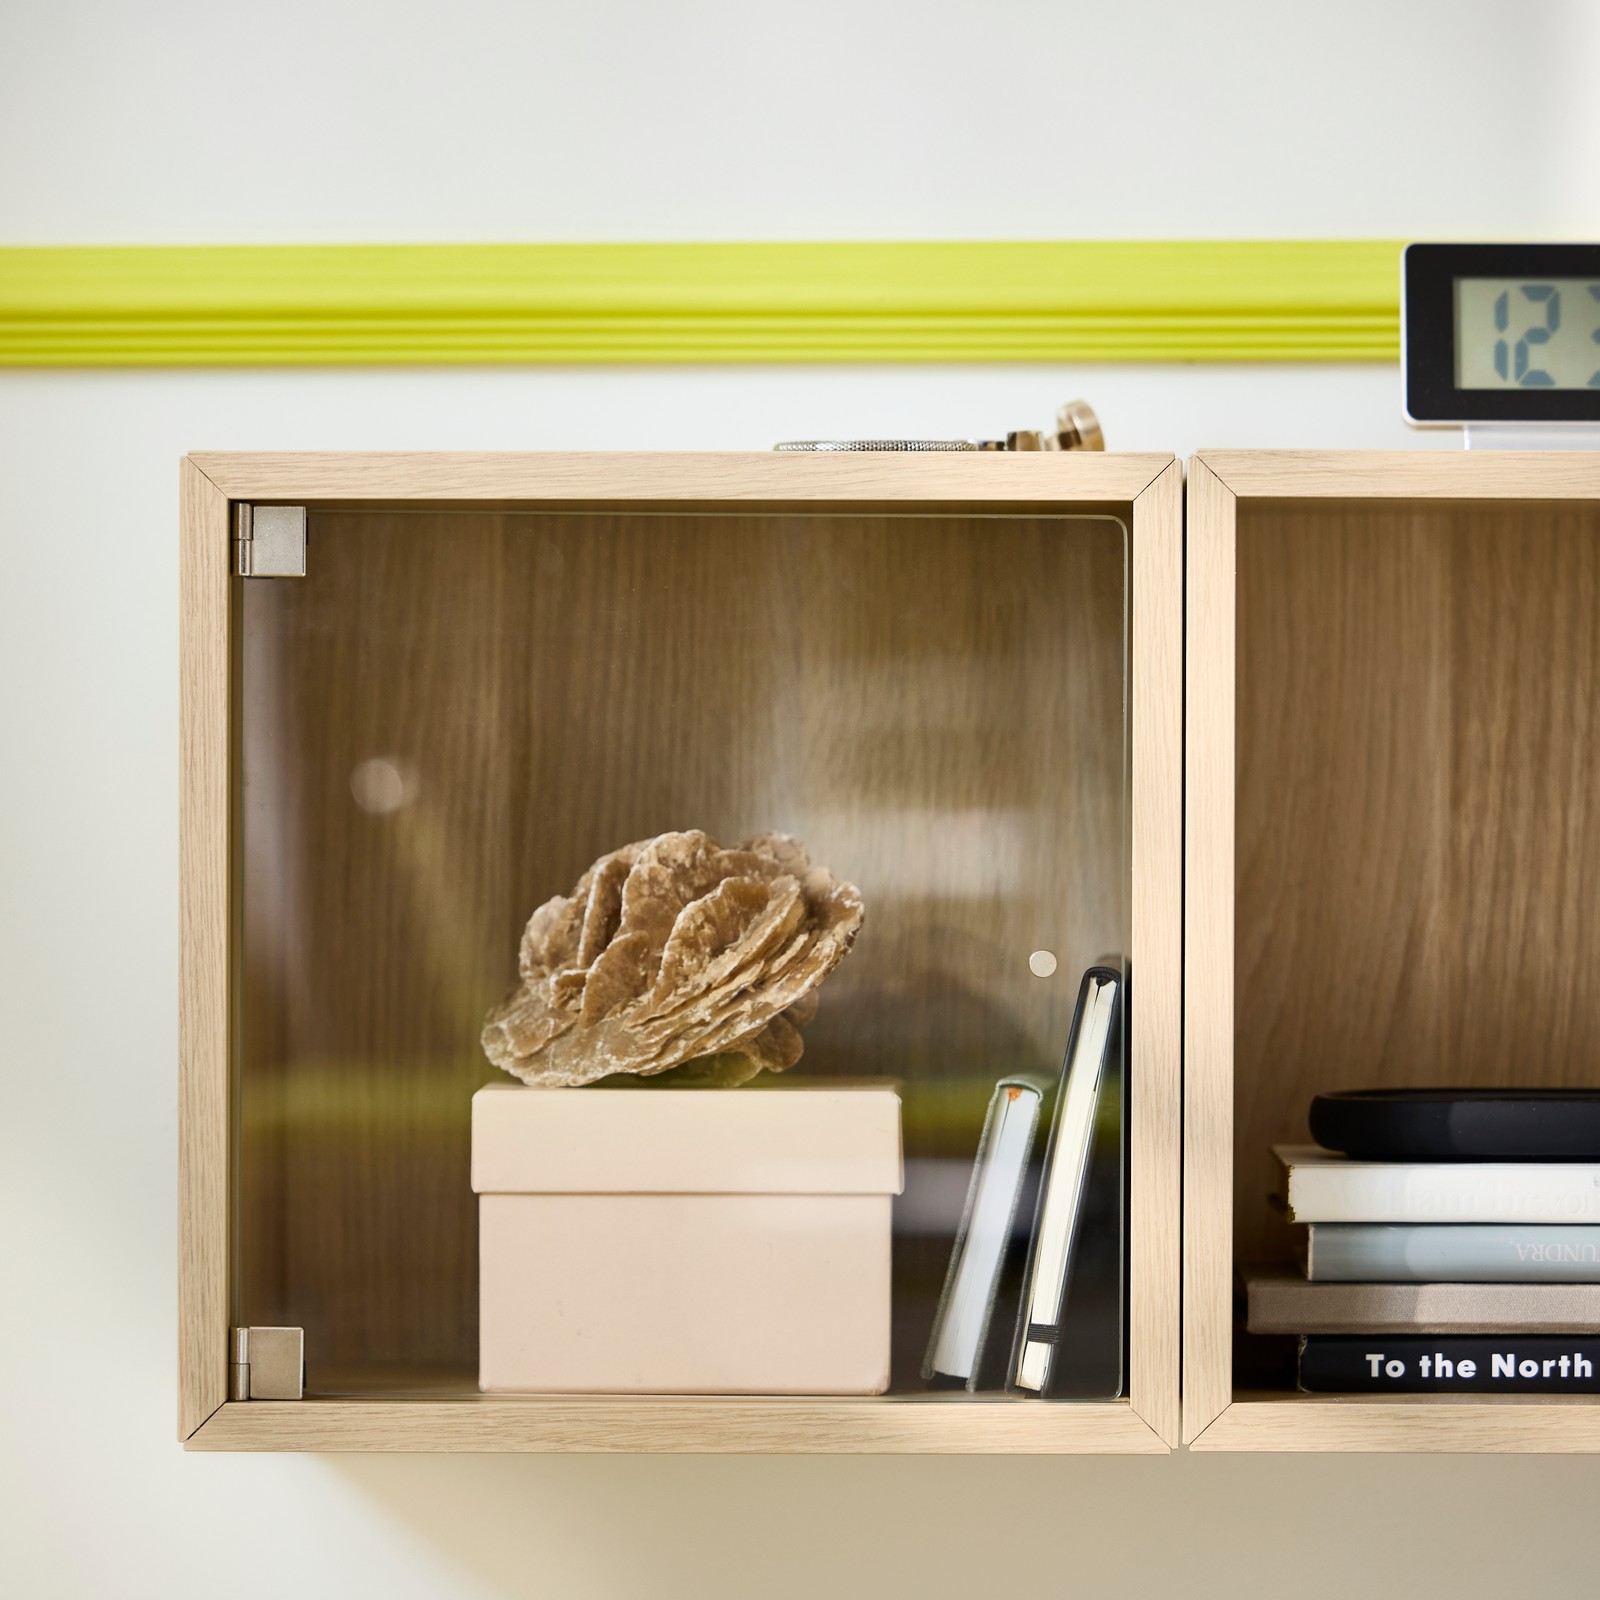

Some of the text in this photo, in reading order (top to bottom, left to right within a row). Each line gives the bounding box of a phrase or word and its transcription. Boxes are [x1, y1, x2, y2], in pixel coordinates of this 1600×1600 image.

[1515, 1243, 1600, 1263] UNDRA
[1365, 1353, 1593, 1378] To the North
